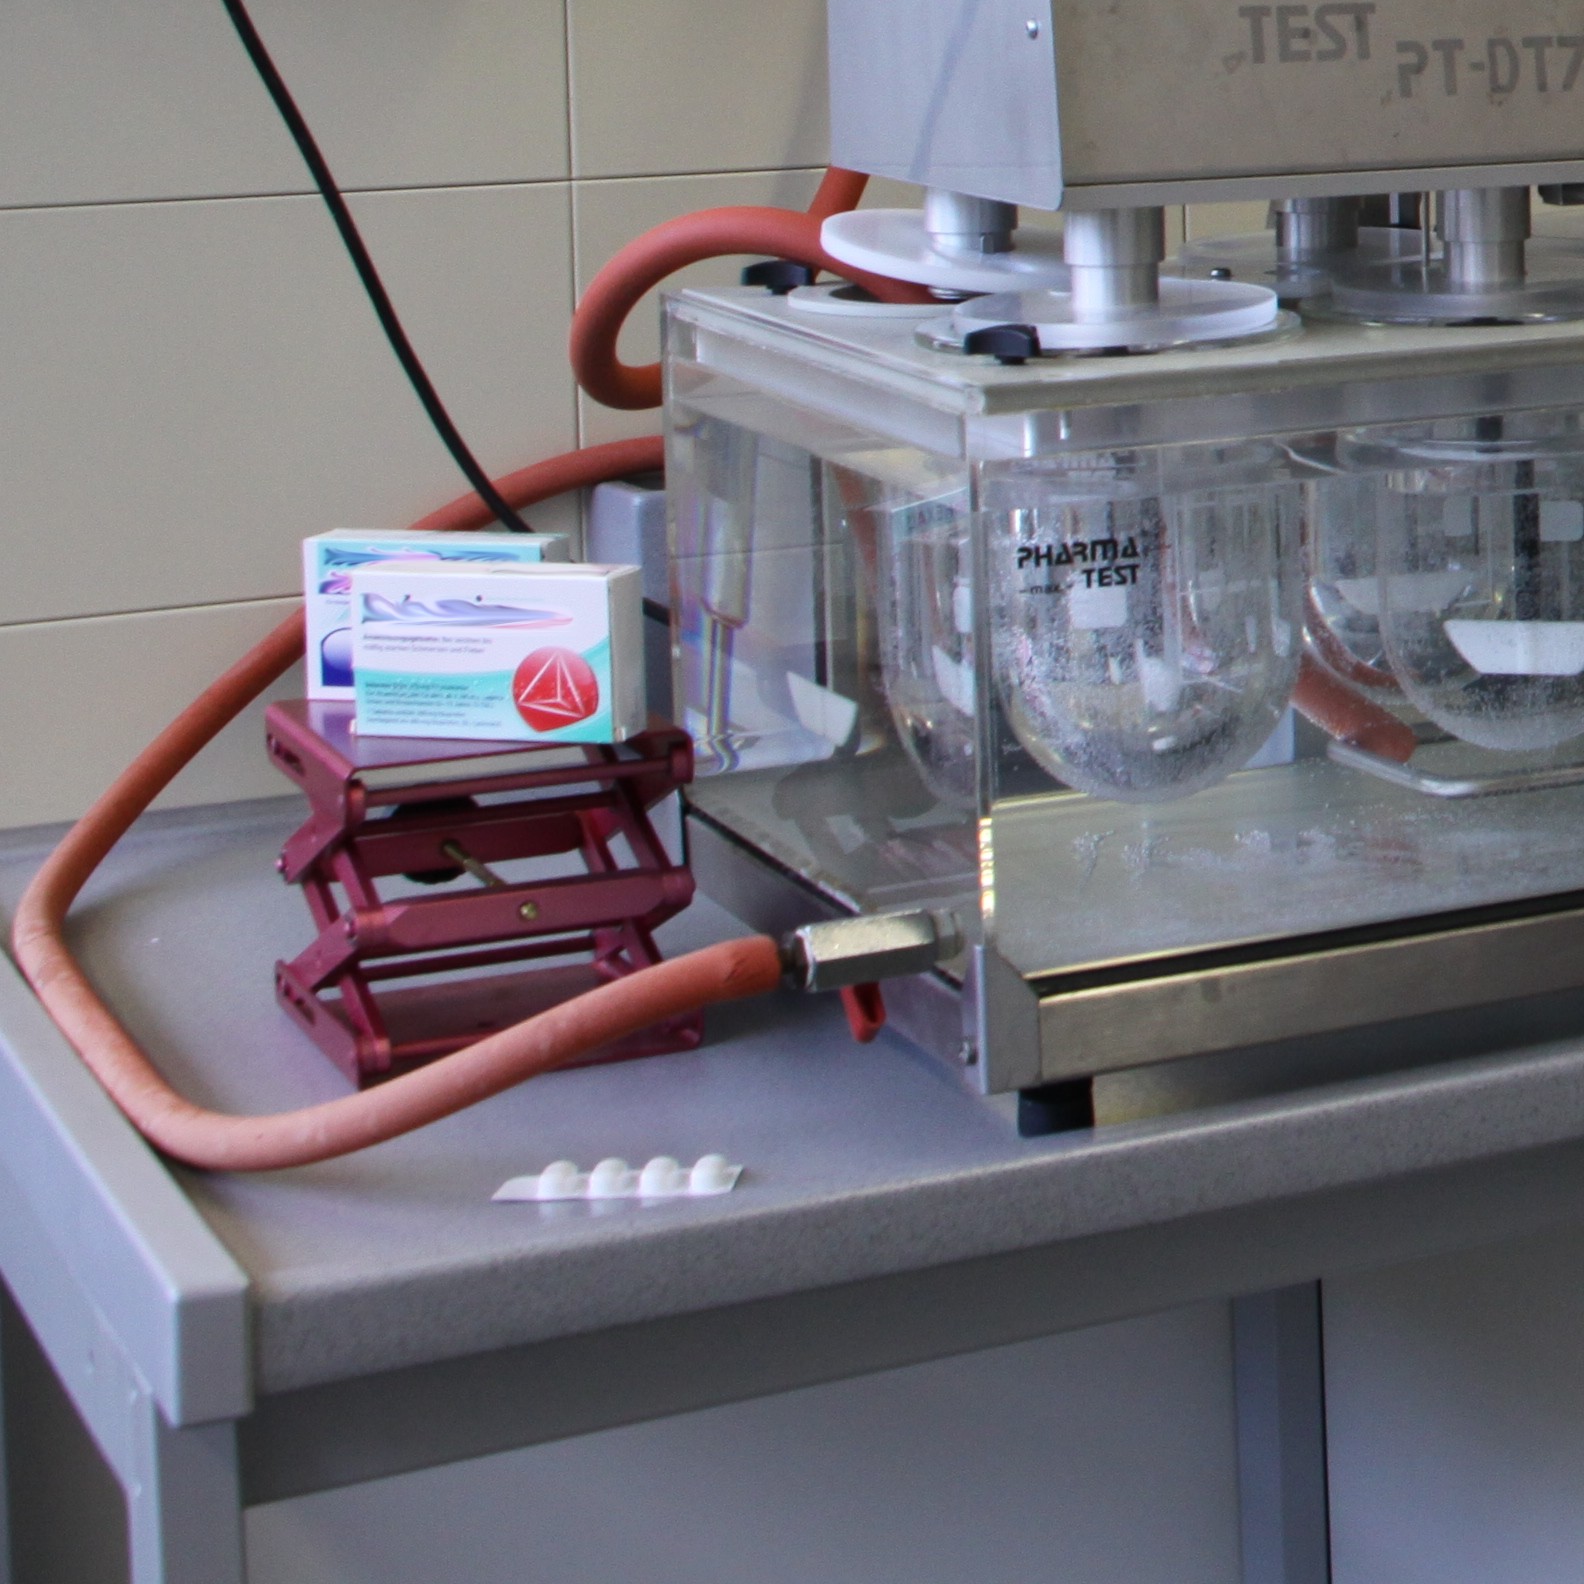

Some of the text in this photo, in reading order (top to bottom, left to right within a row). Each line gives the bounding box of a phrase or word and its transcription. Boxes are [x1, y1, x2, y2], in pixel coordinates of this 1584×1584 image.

[1238, 3, 1377, 64] TEST
[1017, 536, 1140, 569] PHARMA
[1082, 564, 1140, 588] TEST
